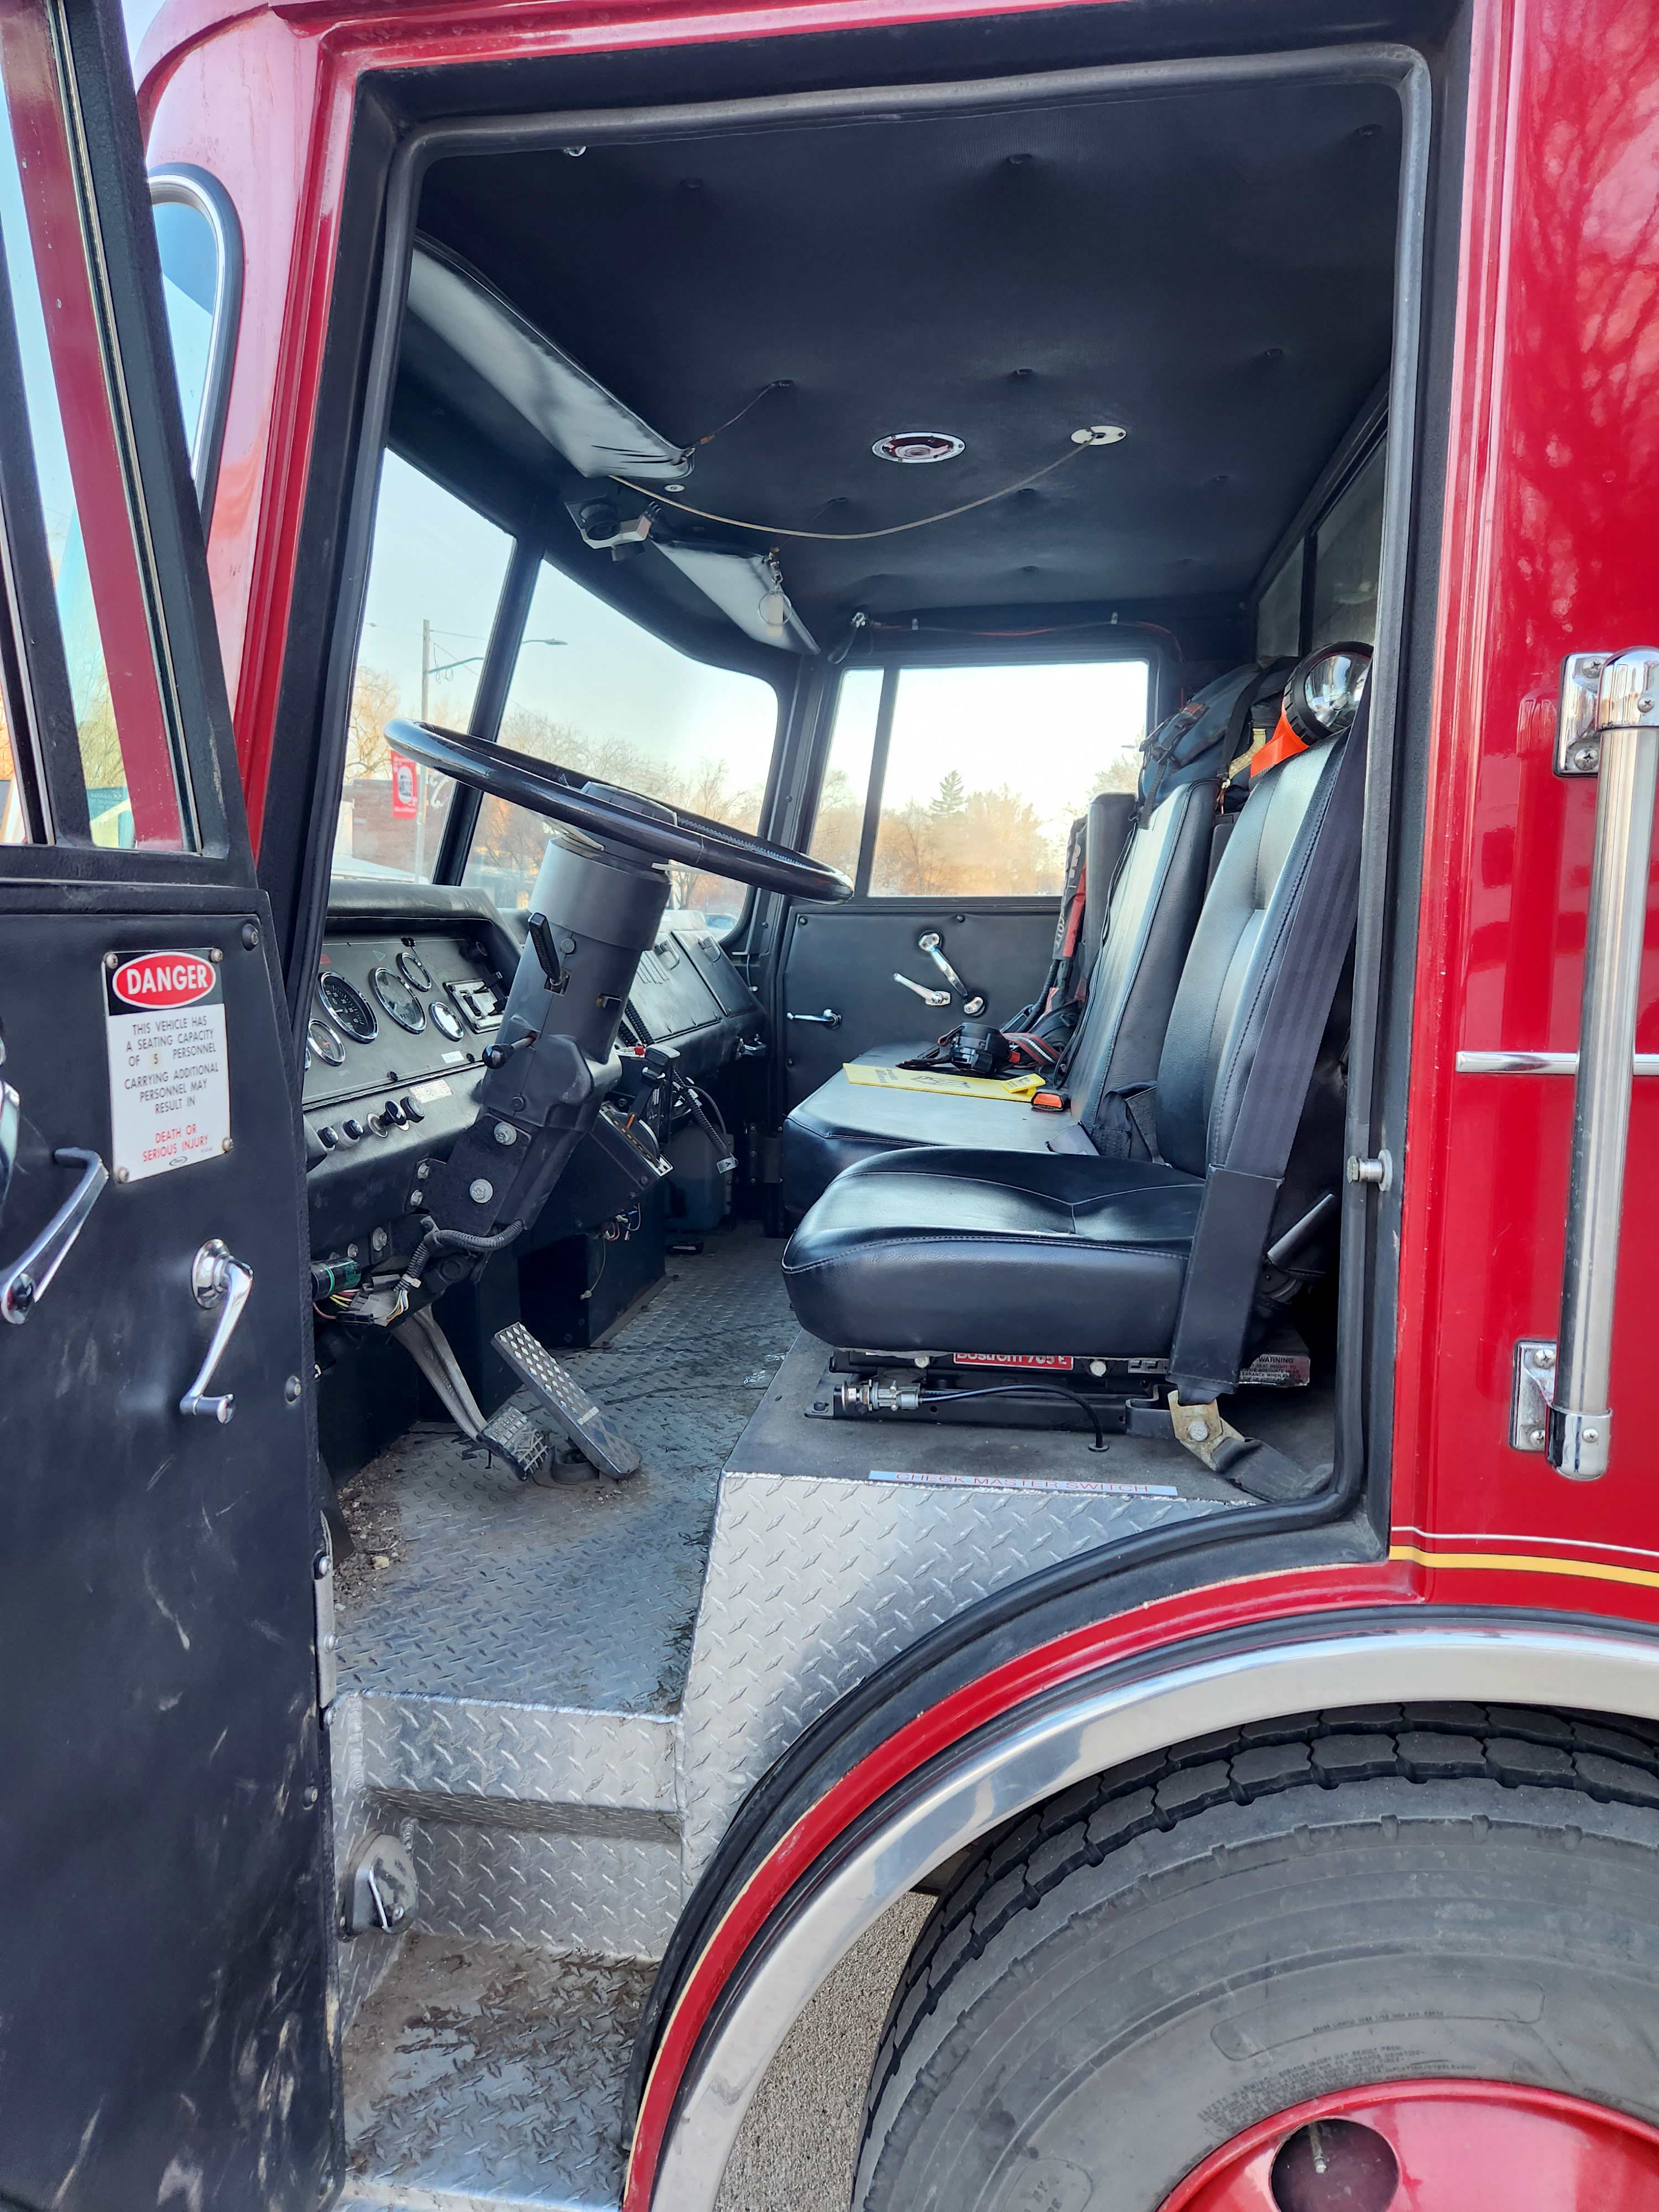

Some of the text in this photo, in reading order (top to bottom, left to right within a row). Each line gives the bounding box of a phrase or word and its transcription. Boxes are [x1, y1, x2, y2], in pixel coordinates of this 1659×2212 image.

[127, 964, 208, 995] DANGER
[132, 1015, 207, 1035] THIS VEHICLE HAS
[126, 1029, 214, 1052] A SEATING CAPACITY
[128, 1042, 216, 1066] OF 5 PERSONNEL
[124, 1062, 219, 1089] CARRYING ADDITIONAL
[140, 1078, 207, 1102] PERSONNEL MAY
[155, 1095, 195, 1114] RESULT IN
[155, 1124, 197, 1144] DEATH OR
[143, 1143, 178, 1162] SERIOUS
[181, 1134, 208, 1151] INJURY
[896, 1473, 1148, 1492] CHECK MASTER SWITCH
